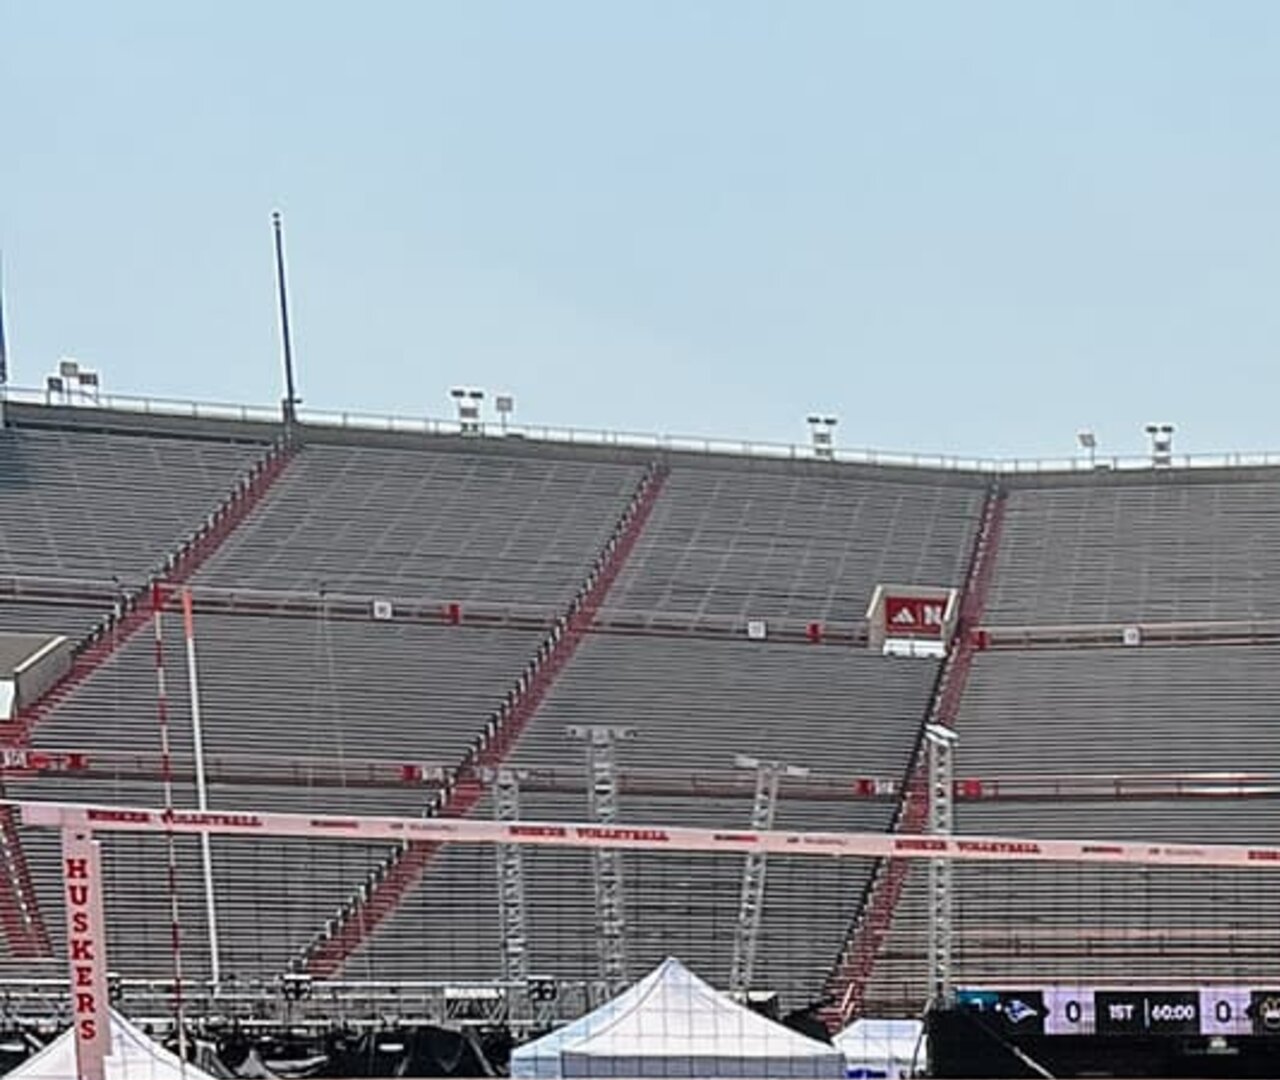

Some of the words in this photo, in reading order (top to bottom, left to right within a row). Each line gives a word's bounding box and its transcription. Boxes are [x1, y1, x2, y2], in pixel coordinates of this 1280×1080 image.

[65, 858, 97, 1040] HUSKERS
[1065, 1001, 1082, 1023] 0
[1215, 1000, 1232, 1023] 0
